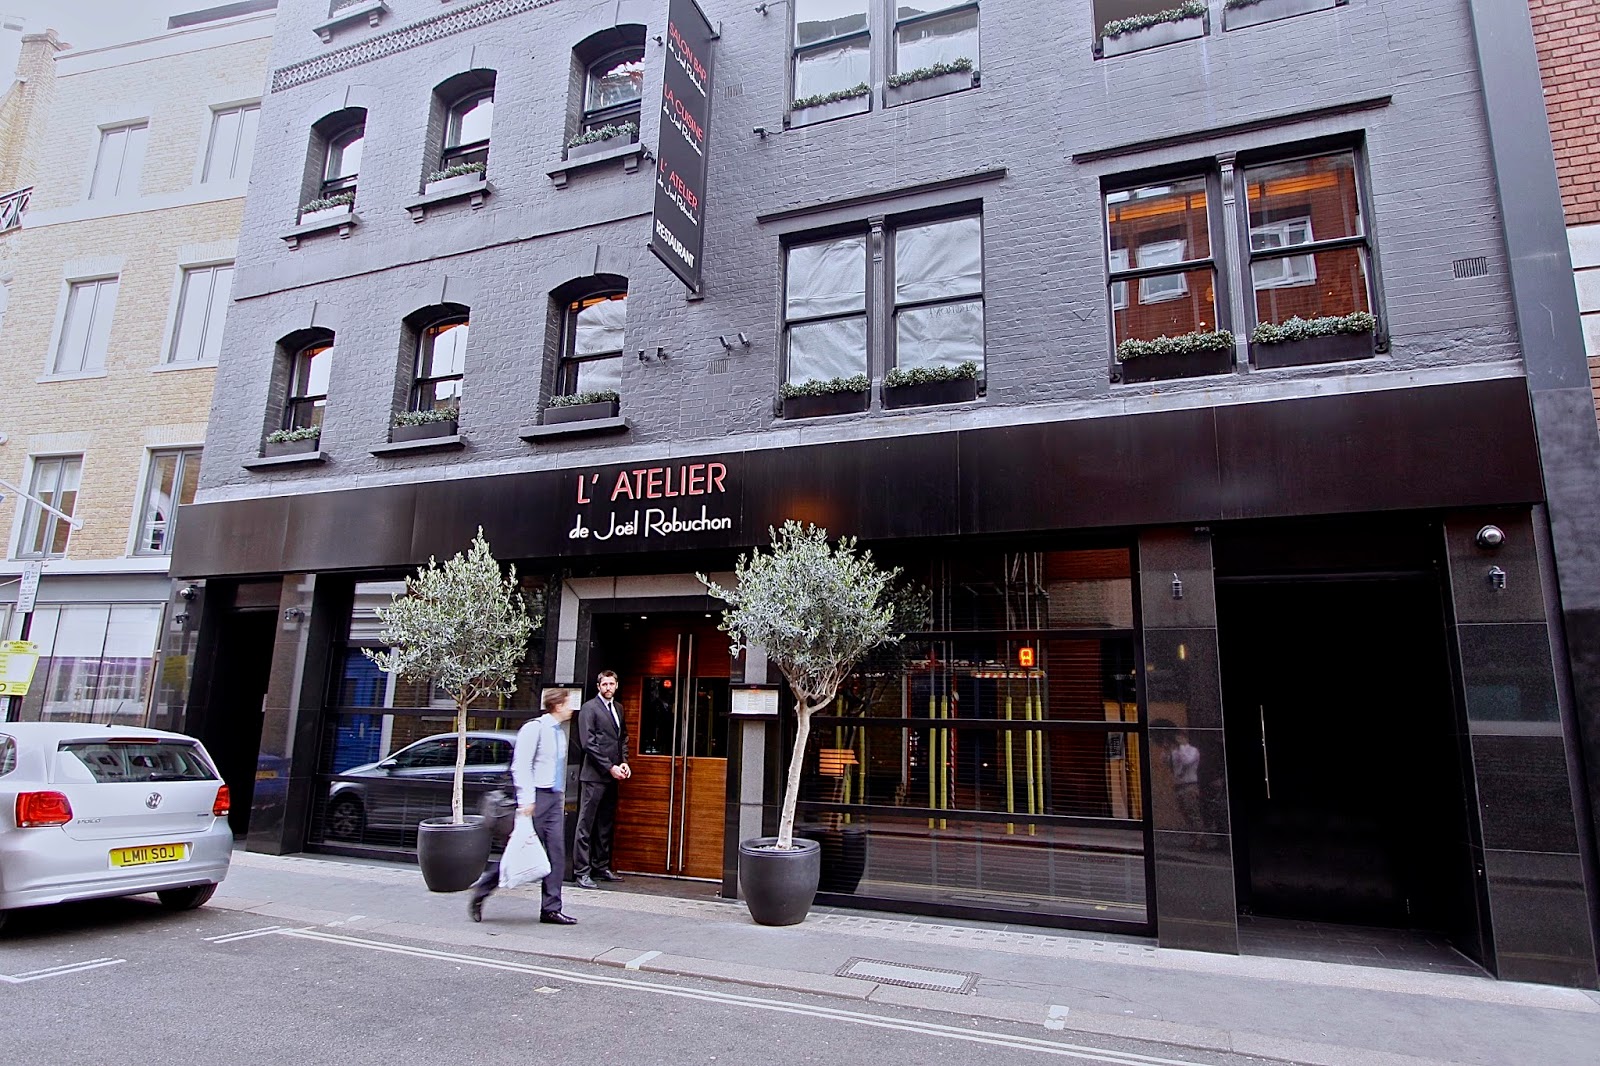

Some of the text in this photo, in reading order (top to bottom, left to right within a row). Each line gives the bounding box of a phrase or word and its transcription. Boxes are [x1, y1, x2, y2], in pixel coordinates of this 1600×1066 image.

[669, 22, 707, 83] SALON BAR
[686, 62, 706, 97] Robuchon
[664, 83, 703, 142] LA CUISINE
[681, 123, 702, 156] Robuchon
[669, 170, 698, 210] ATELIER
[676, 195, 698, 226] Robuchon
[656, 219, 694, 268] RESTAURANT
[610, 462, 727, 501] ATELIER
[568, 505, 732, 540] de Joël Robuchon
[122, 847, 175, 863] LM11 SOJ
